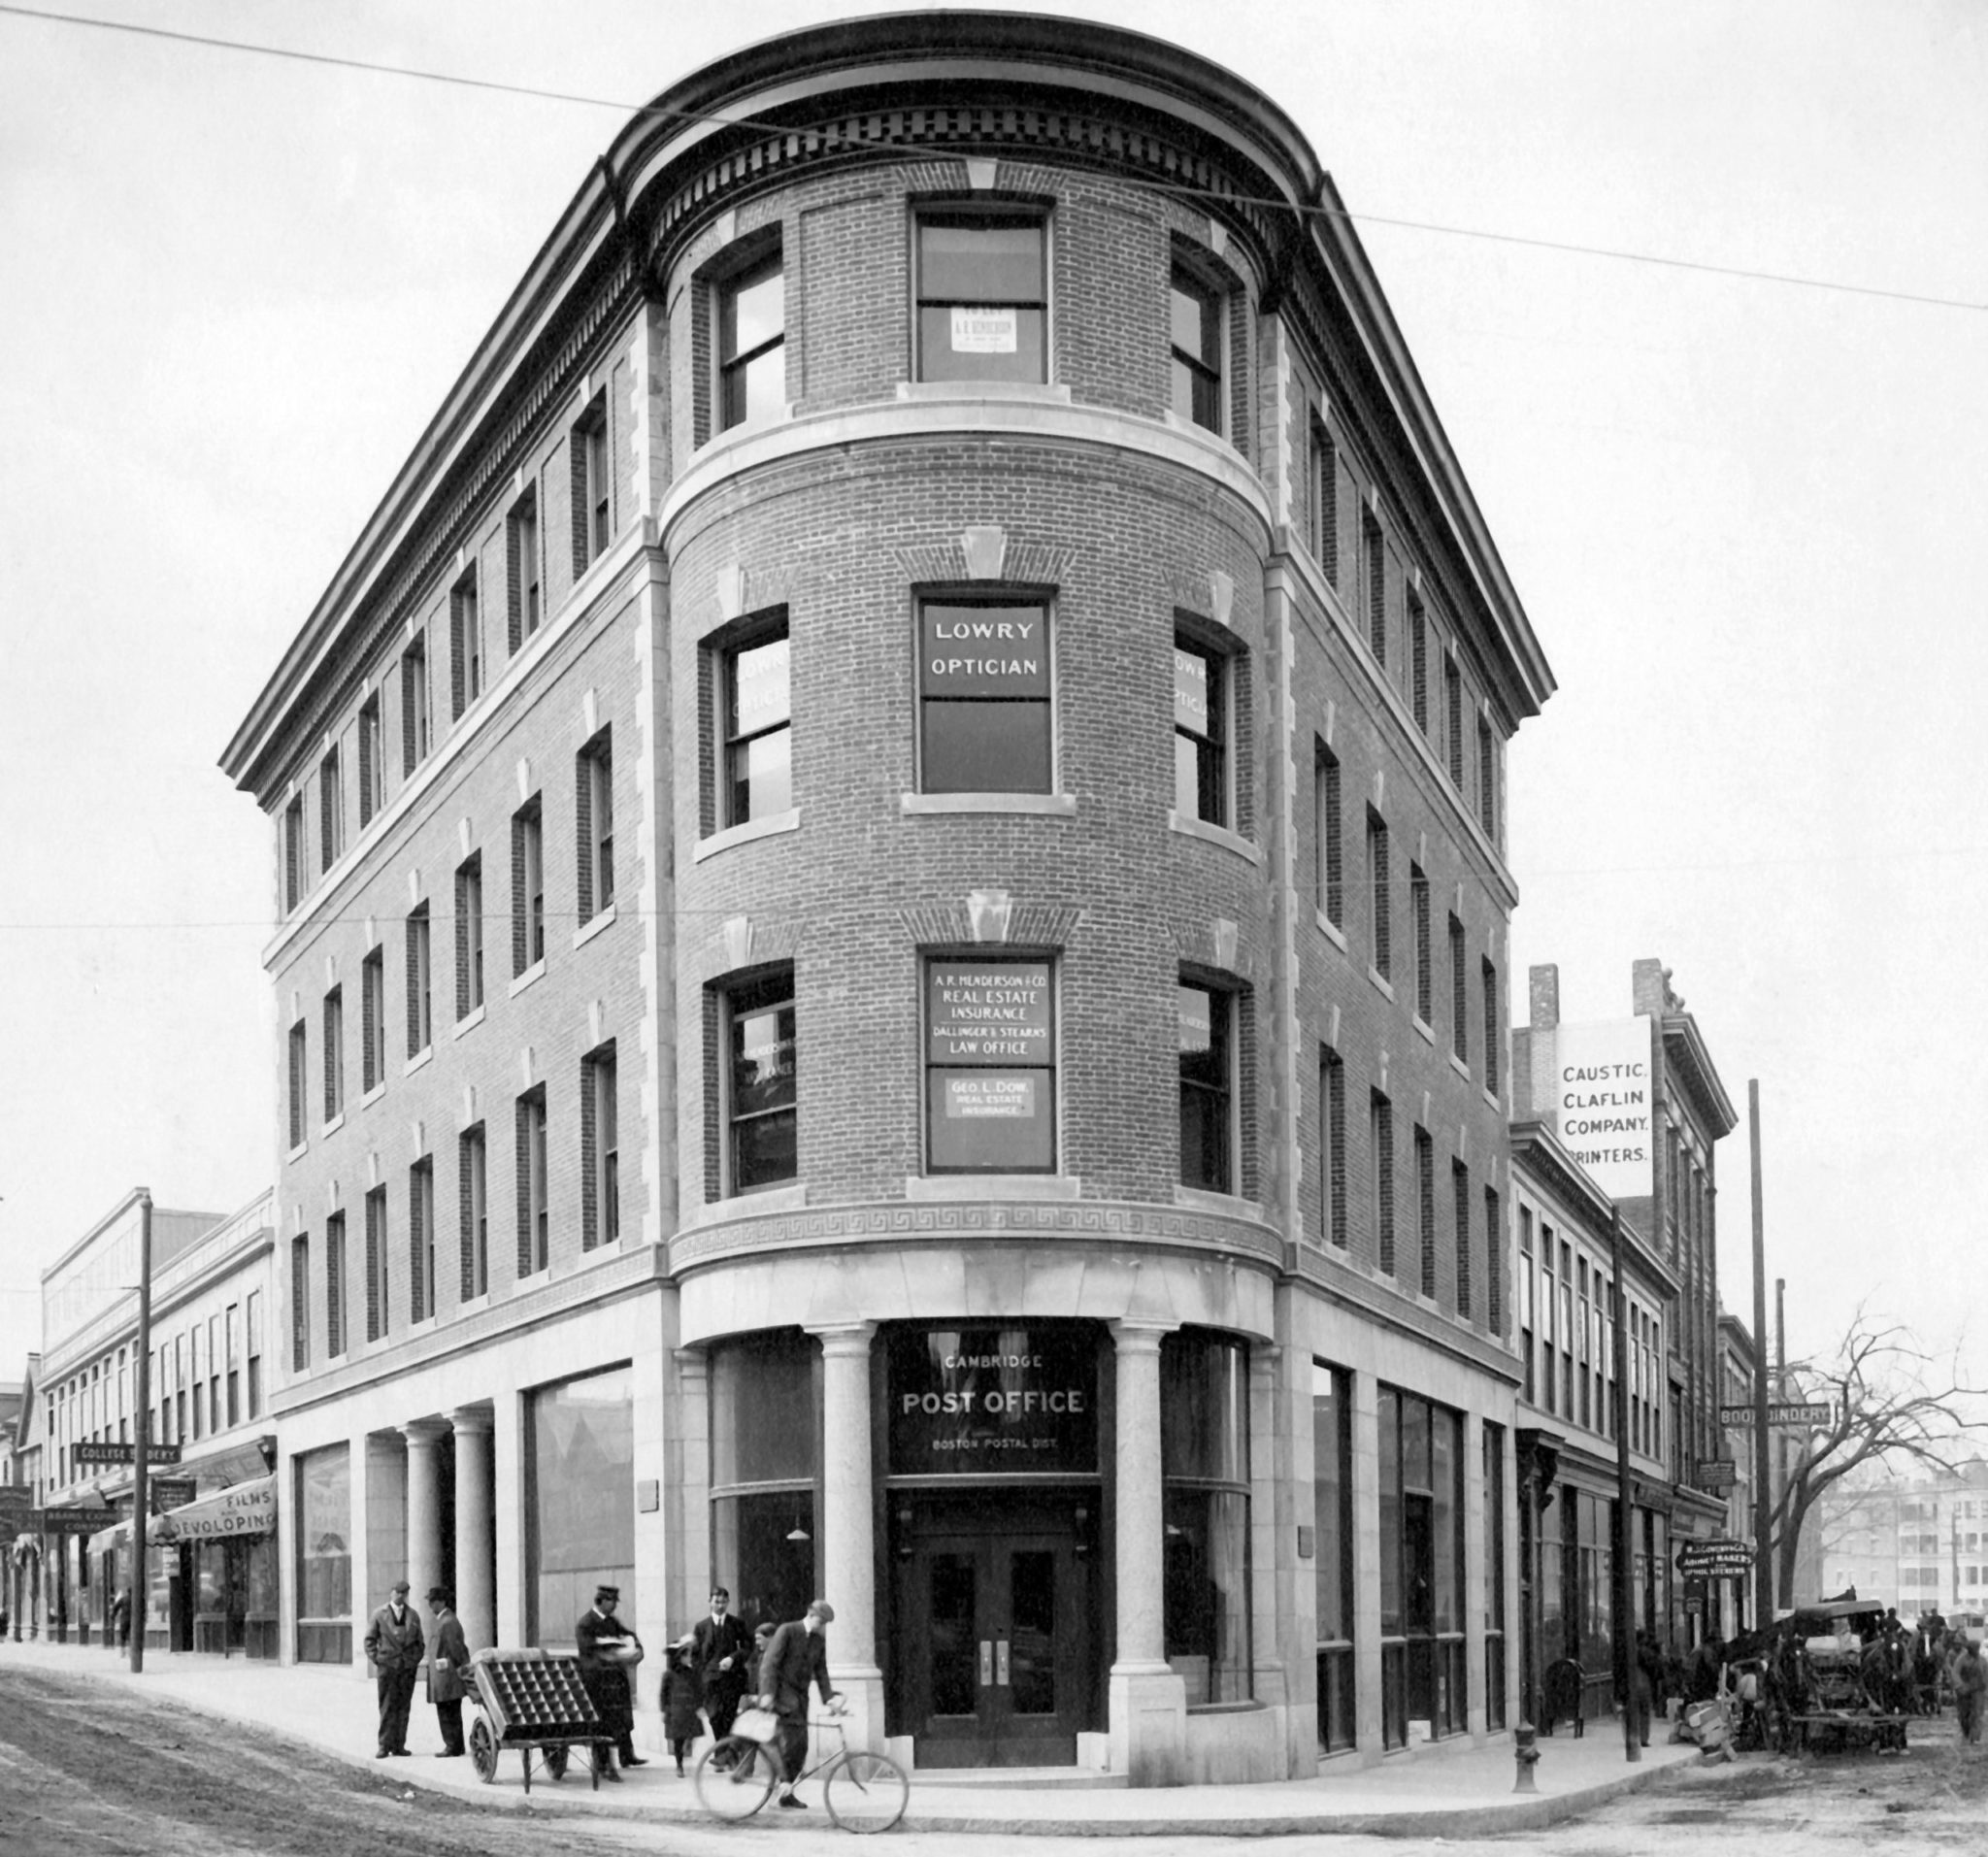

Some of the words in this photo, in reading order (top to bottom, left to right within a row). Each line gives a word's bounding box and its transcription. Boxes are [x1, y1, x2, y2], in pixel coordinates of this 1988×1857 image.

[935, 622, 1034, 639] LOWRY
[931, 658, 1038, 676] OPTICIAN
[959, 975, 1022, 987] HENDERSON
[943, 990, 980, 1004] REAL
[985, 990, 1038, 1005] ESTATE
[951, 1007, 1027, 1020] INSURANCE
[933, 1026, 988, 1038] DALLINGER
[1000, 1027, 1046, 1039] STEARNS
[949, 1041, 978, 1054] LAW
[982, 1041, 1029, 1055] OFFICE
[956, 1095, 983, 1105] REAL
[985, 1095, 1023, 1105] ESTATE
[1563, 1089, 1643, 1110] CLAFLIN
[944, 1355, 1043, 1369] CAMBRIDGE
[903, 1391, 976, 1414] POST
[984, 1390, 1084, 1413] OFFICE
[932, 1439, 978, 1450] BOSTON
[984, 1438, 1029, 1449] POSTAL
[82, 1446, 125, 1460] COLLEGE
[226, 1490, 271, 1508] FILMS
